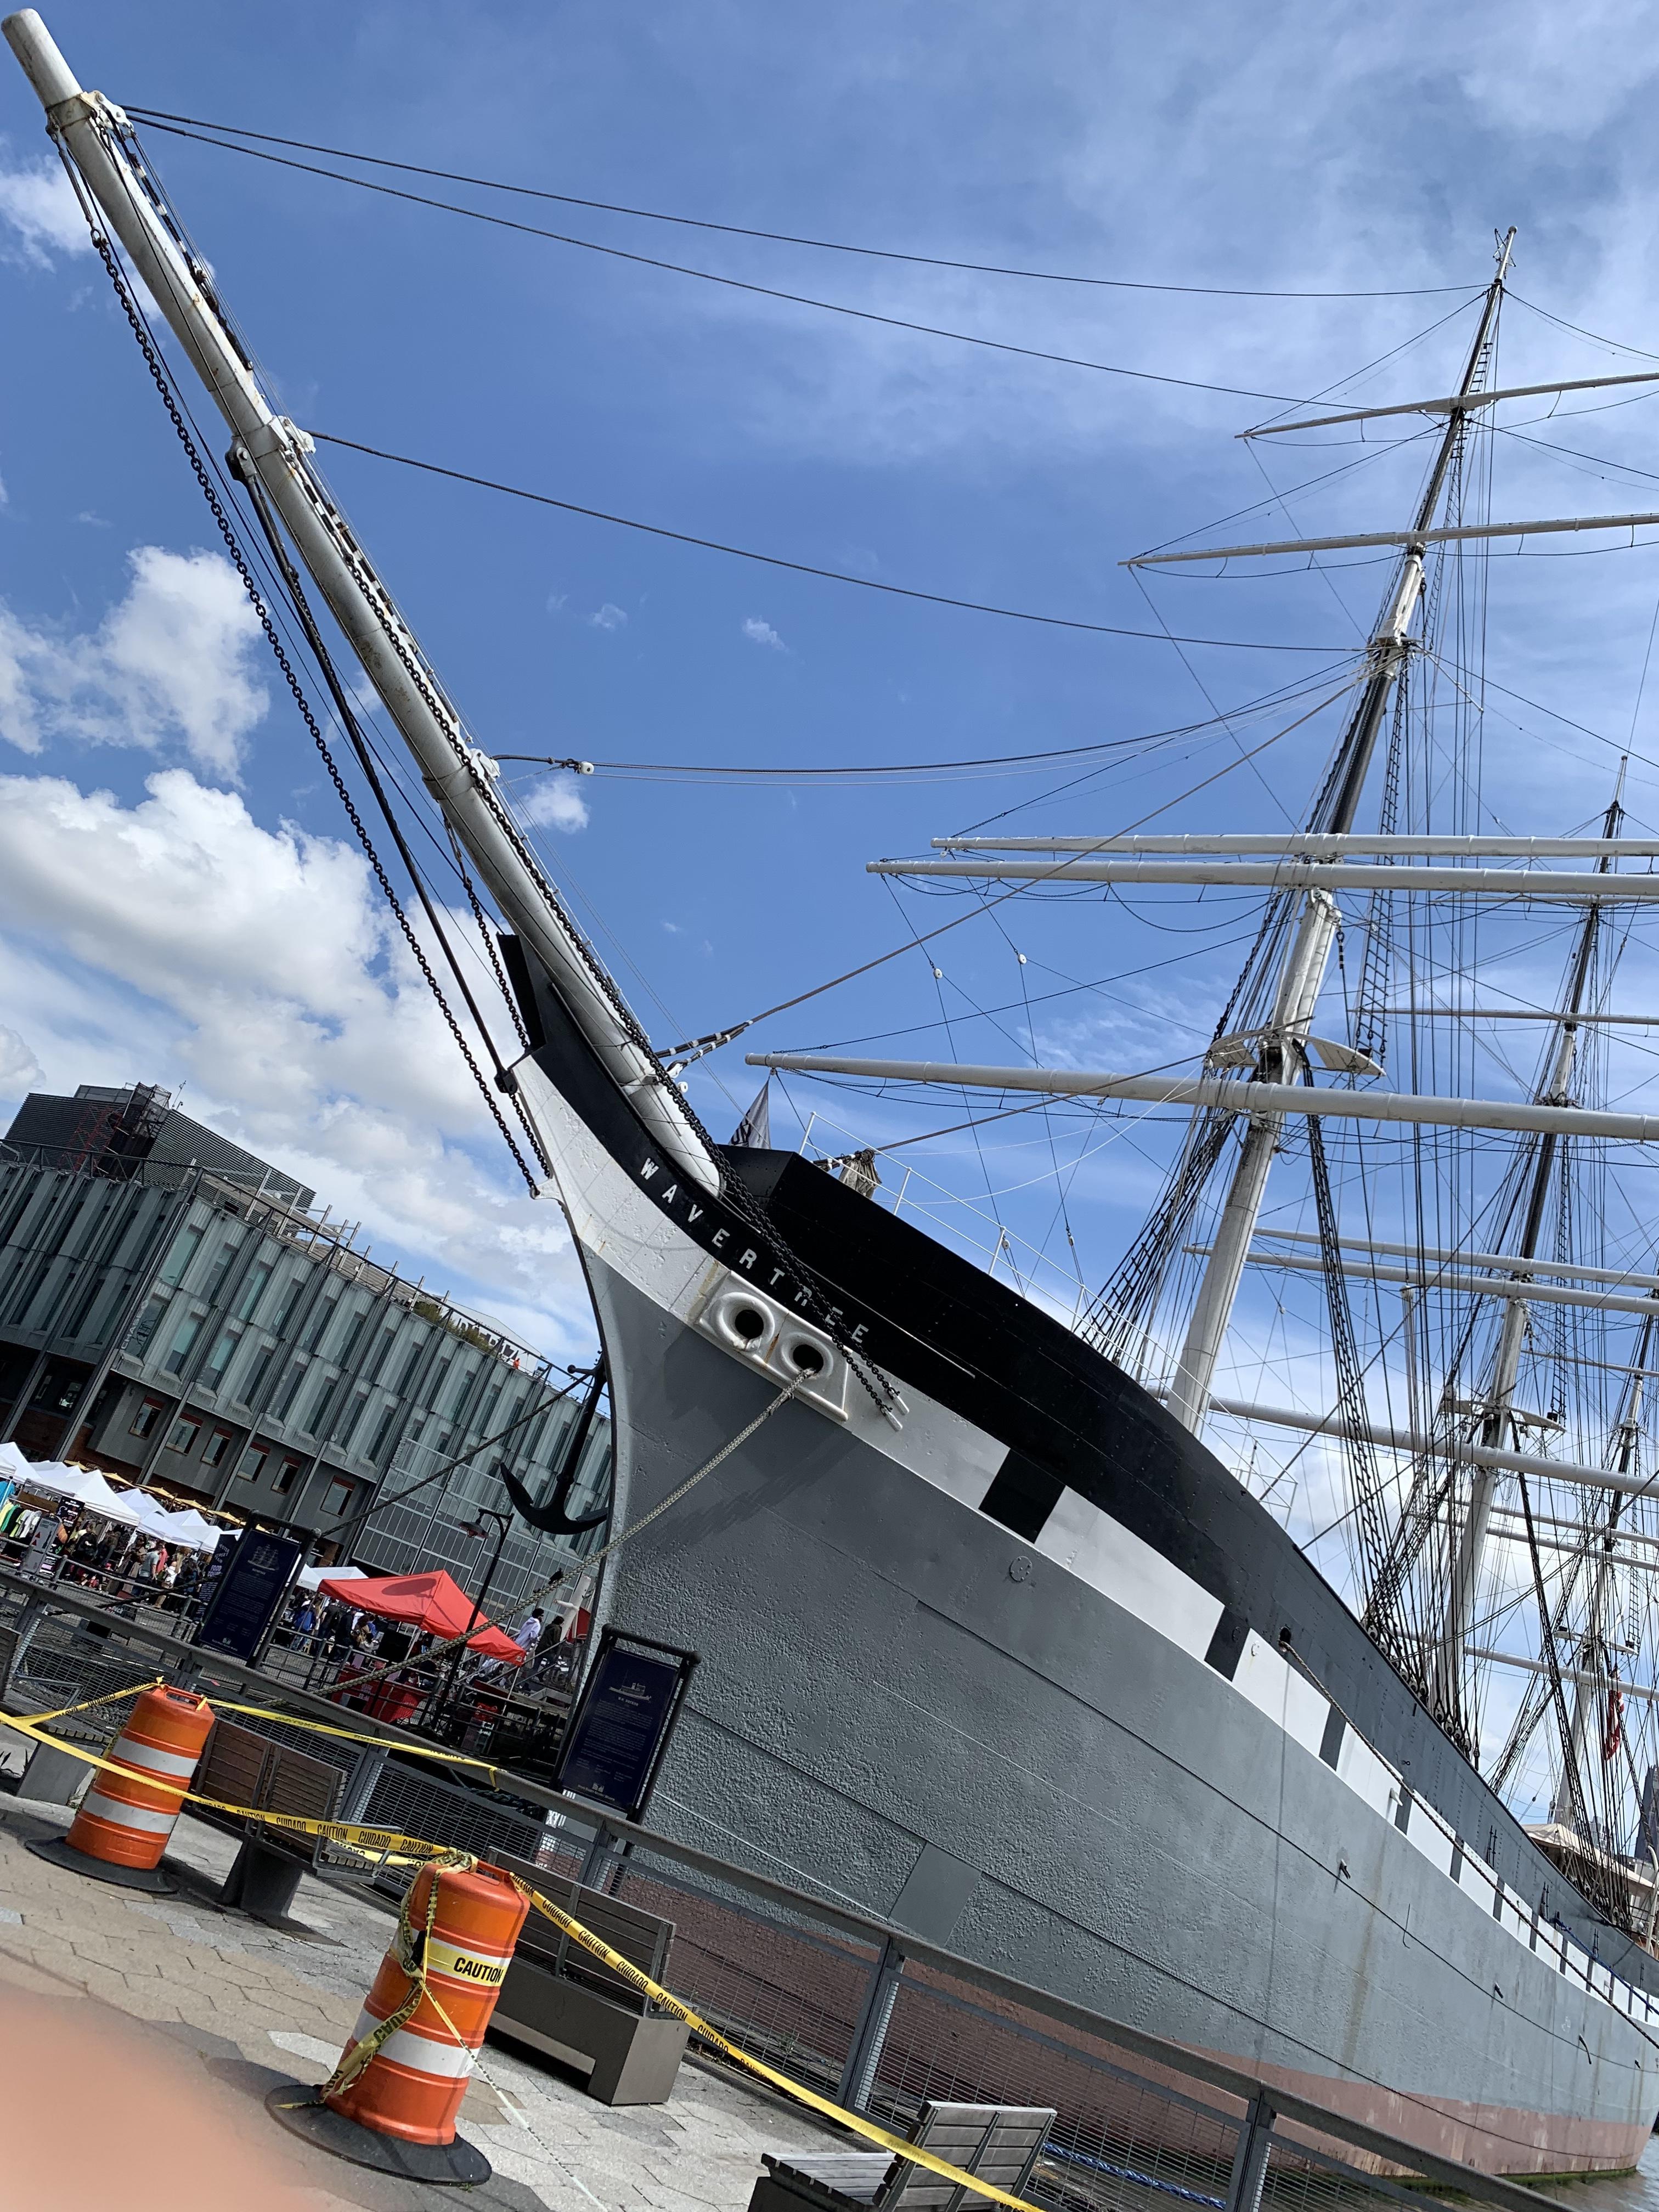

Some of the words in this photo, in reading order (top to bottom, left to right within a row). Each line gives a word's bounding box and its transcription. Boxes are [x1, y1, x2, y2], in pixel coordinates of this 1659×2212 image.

[640, 1158, 868, 1344] WAVERTREE
[276, 1816, 306, 1832] CUIDADO
[317, 1824, 348, 1840] CAUTION
[358, 1831, 391, 1848] CUIDADO
[400, 1838, 433, 1854] CAUTION
[454, 1957, 504, 1983] CAUTION
[542, 1899, 573, 1929] CUIDADO
[578, 1930, 611, 1960] CAUTION
[616, 1961, 649, 1991] CUIDADO
[656, 1992, 688, 2022] CAUTION
